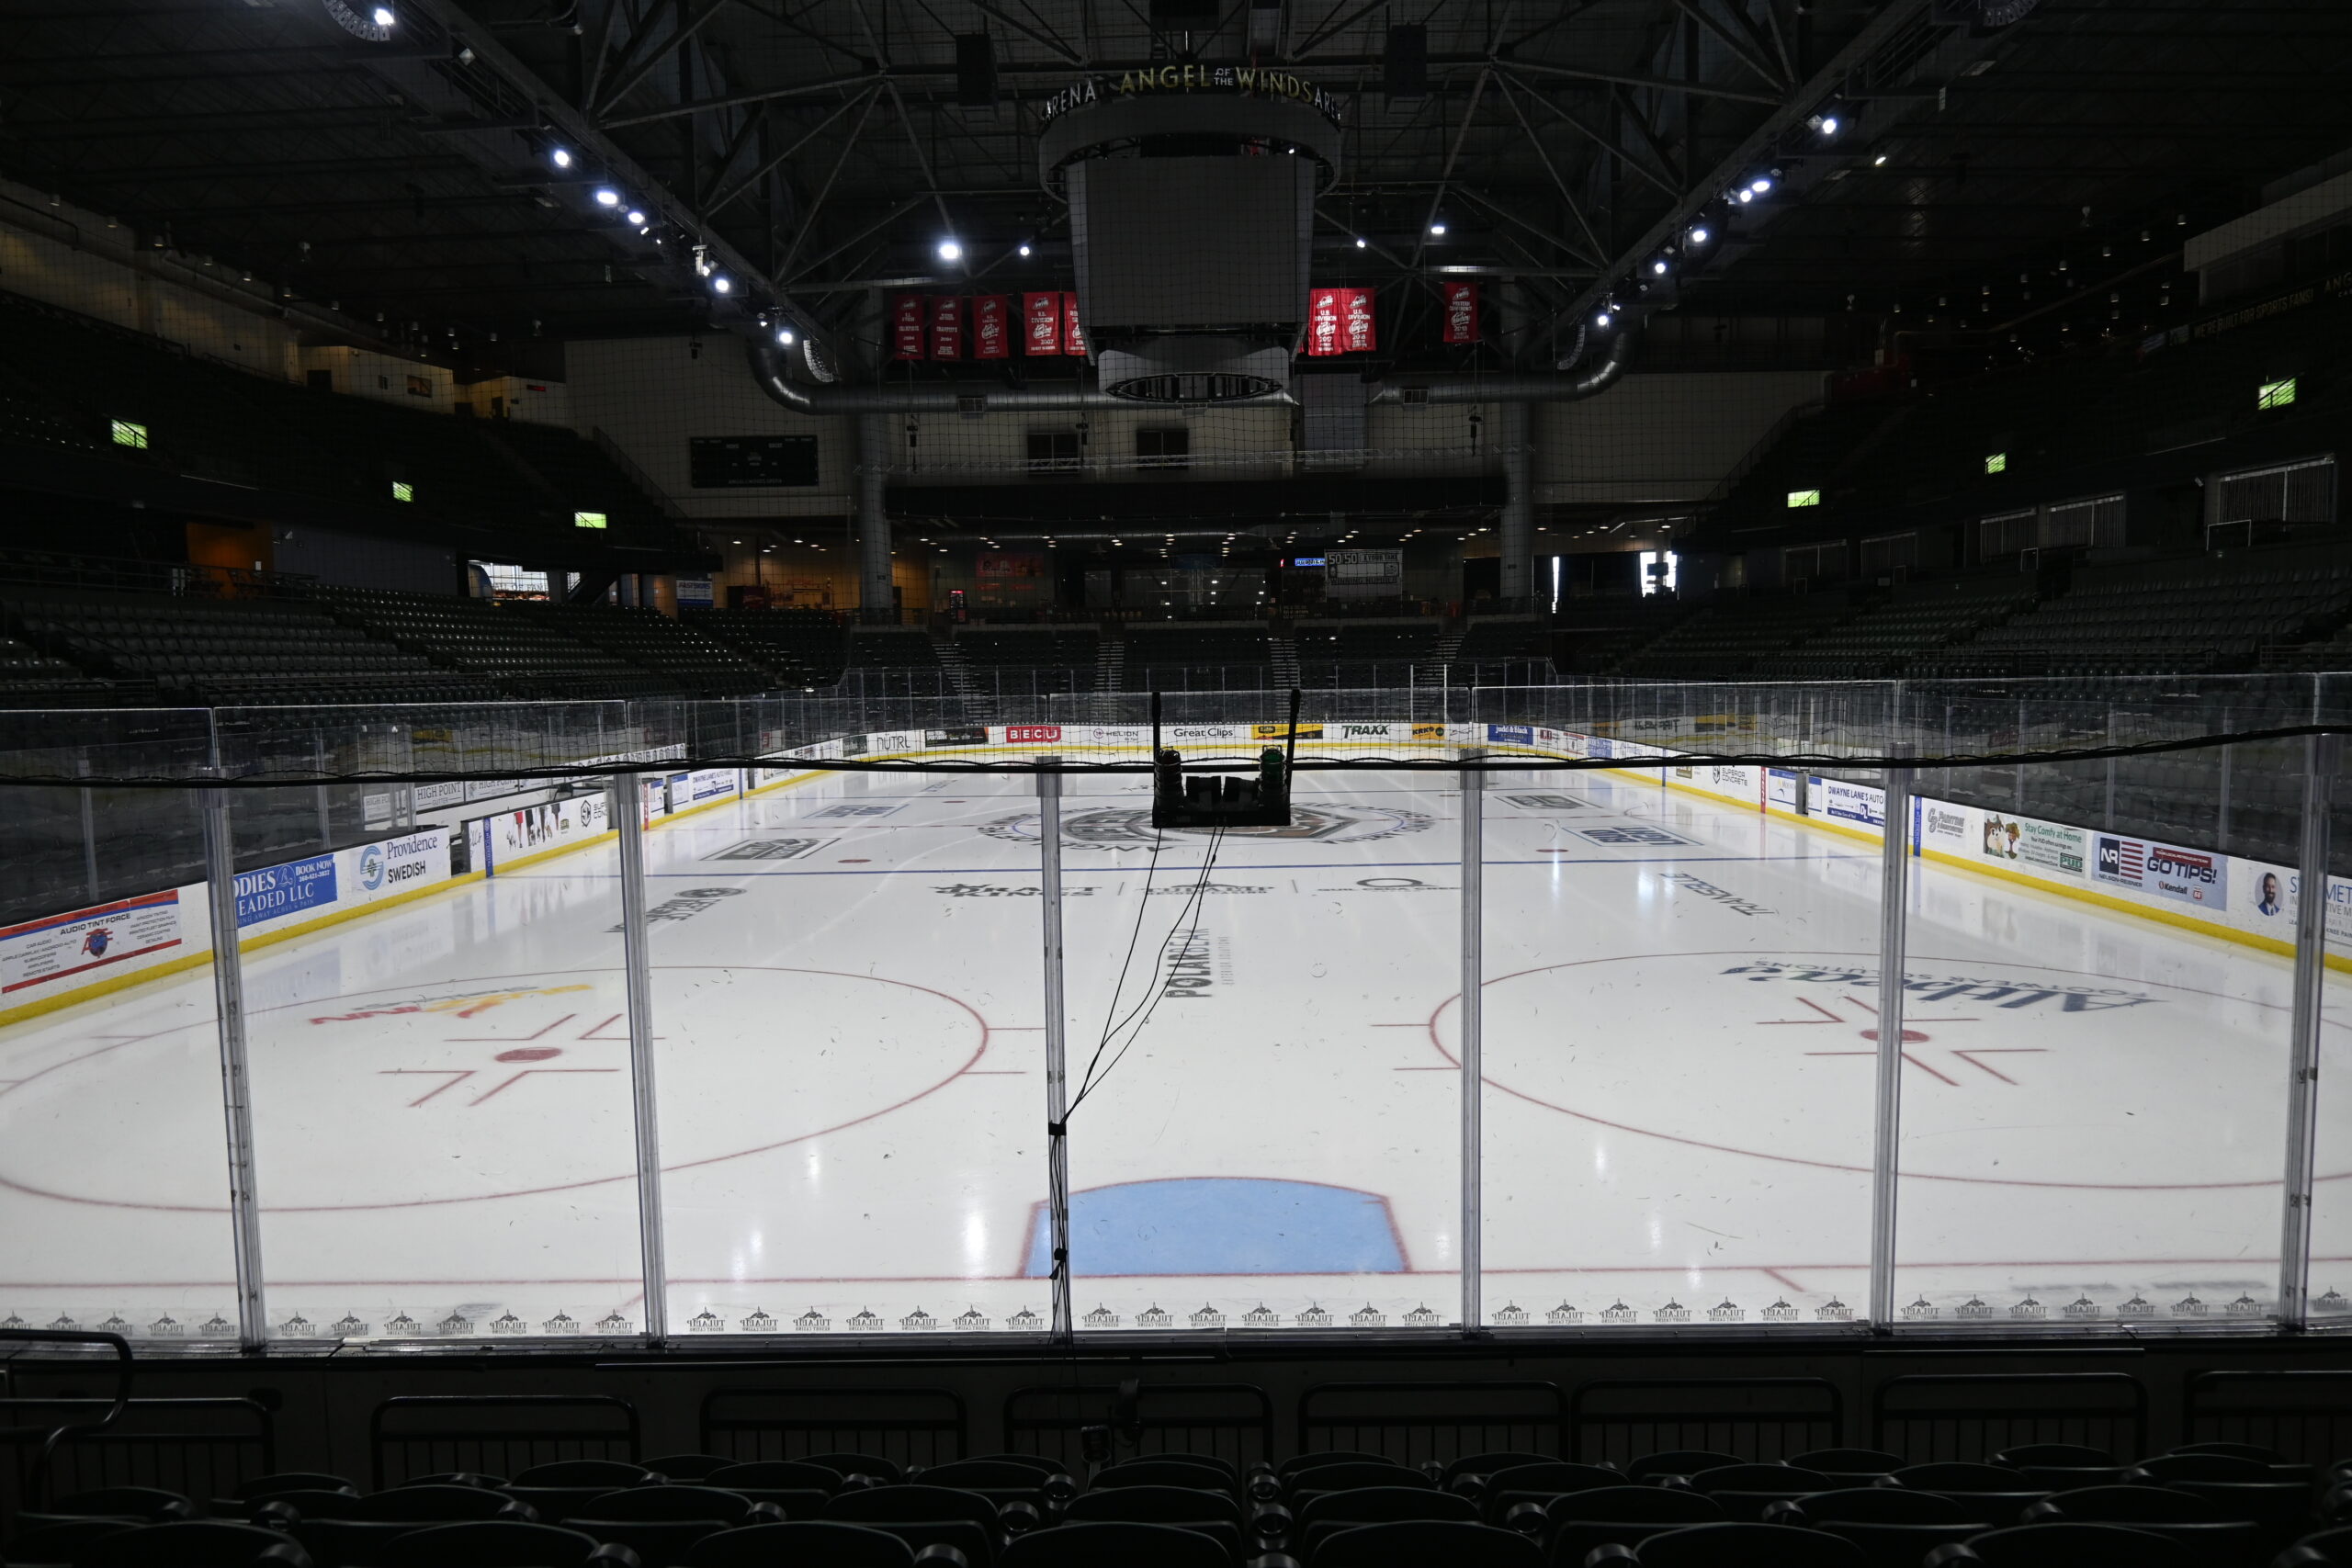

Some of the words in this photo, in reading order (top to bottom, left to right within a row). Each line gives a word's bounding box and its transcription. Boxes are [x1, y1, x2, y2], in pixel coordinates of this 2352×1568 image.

[1120, 64, 1211, 95] ANGEL
[1216, 68, 1231, 76] OF
[1214, 77, 1234, 86] THE
[1236, 66, 1314, 103] WINDS
[1046, 80, 1096, 122] ARENA
[2239, 308, 2256, 323] FOR
[2256, 297, 2288, 318] SPORTS
[1329, 554, 1357, 565] 50/50
[1010, 728, 1057, 739] BECU
[1173, 728, 1204, 737] Great
[1207, 728, 1233, 738] Clips
[1342, 725, 1389, 739] TRAXX
[1722, 768, 1745, 777] SUPERIOR
[1722, 776, 1748, 785] CONCRETE
[1828, 786, 1849, 797] DWAYNE
[1851, 789, 1869, 801] LANE'S
[1869, 793, 1883, 804] AUTO
[1579, 829, 1640, 842] BUD
[1610, 827, 1689, 845] LIGHT
[2025, 823, 2036, 834] Stay
[2038, 826, 2055, 838] Comfy
[2064, 831, 2082, 843] Home
[387, 835, 437, 859] Providence
[2100, 847, 2118, 864] NR
[296, 863, 315, 875] BOOK
[316, 859, 332, 871] NOW
[2060, 856, 2082, 868] PUD
[2147, 856, 2172, 874] GO
[2175, 863, 2217, 885] TIPS!
[388, 861, 426, 883] SWEDISH
[2164, 883, 2188, 895] Kendall
[239, 890, 285, 916] EADED
[290, 882, 313, 902] LLC
[60, 923, 85, 935] AUDIO
[87, 919, 105, 928] TINT
[106, 913, 130, 924] FORCE
[1948, 976, 2147, 998] FOOTWEAR
